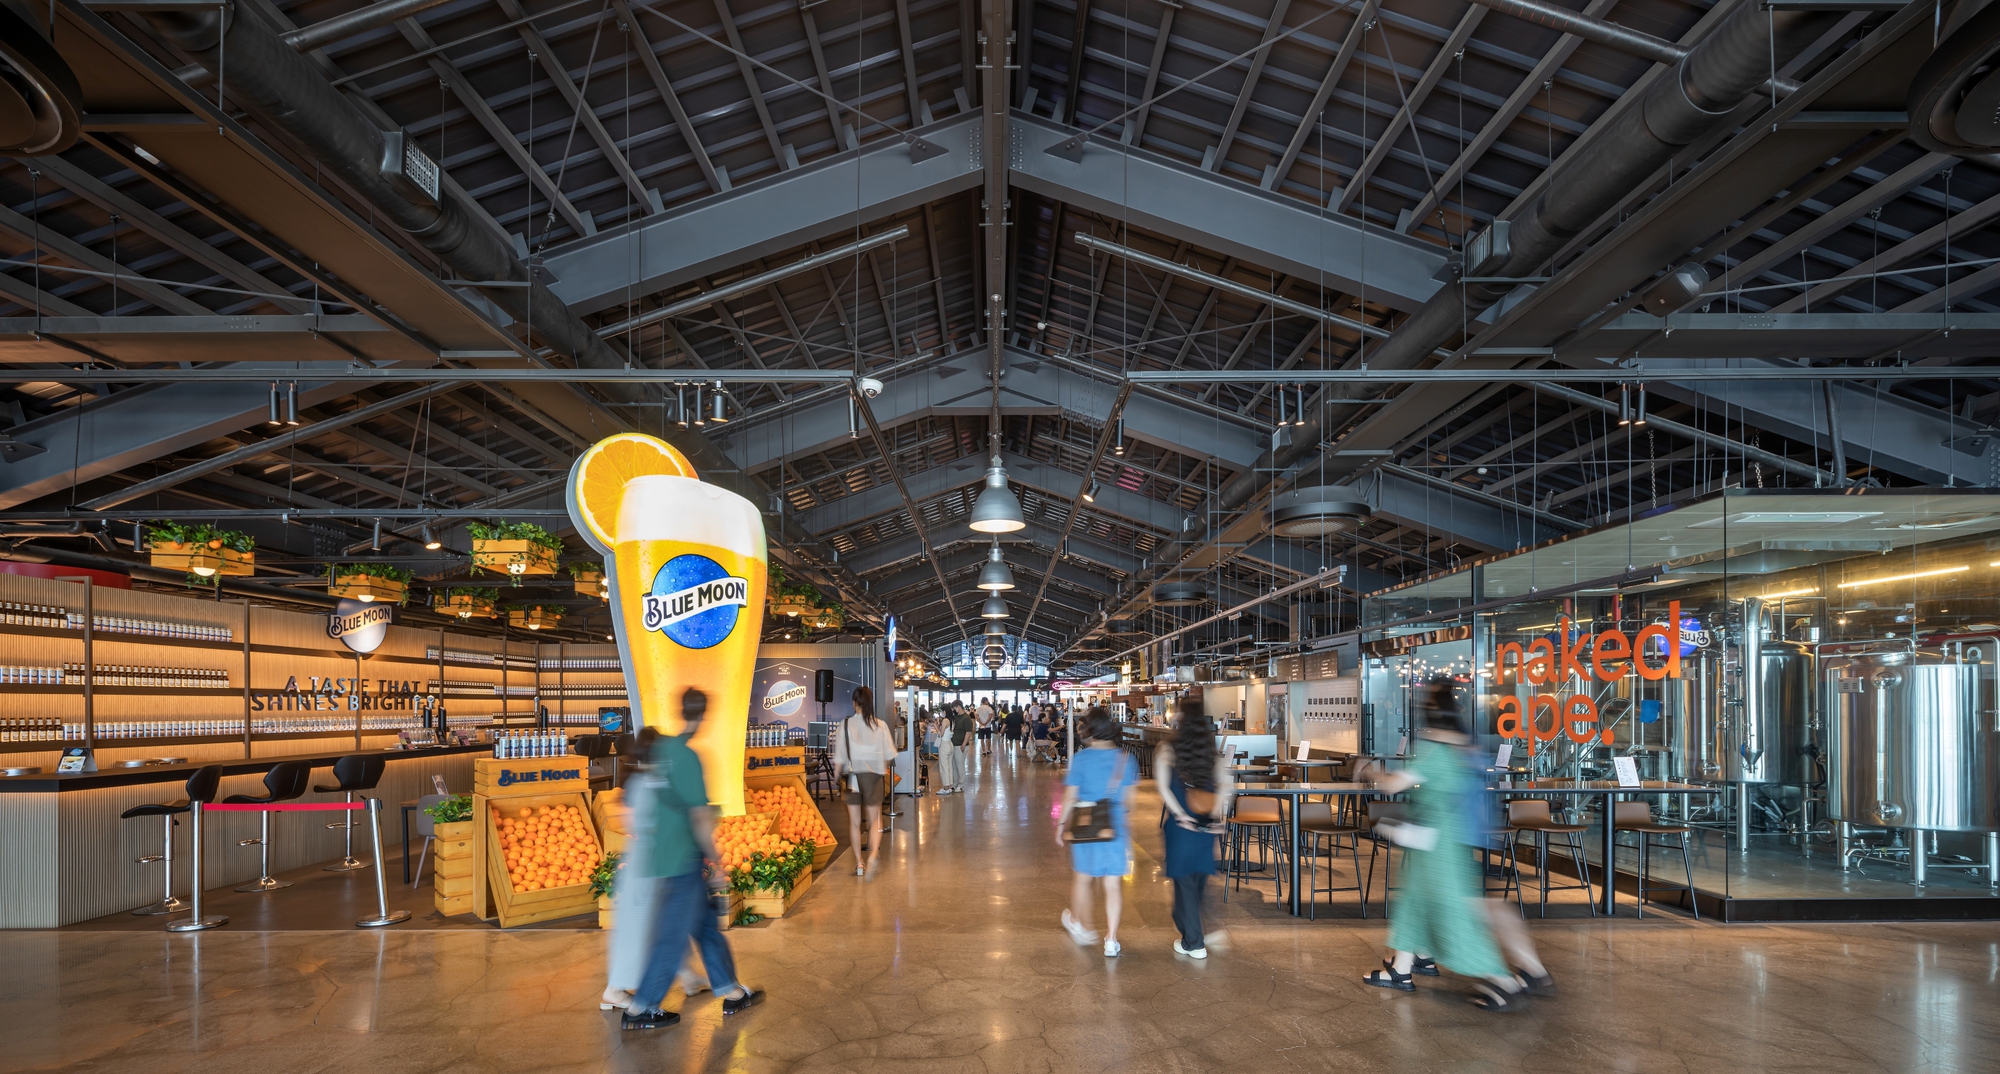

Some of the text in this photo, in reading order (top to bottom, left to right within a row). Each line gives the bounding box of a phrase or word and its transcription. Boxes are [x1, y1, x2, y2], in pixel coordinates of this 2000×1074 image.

[644, 582, 745, 628] BLUE MOON
[330, 607, 390, 635] BLUE MOON
[1497, 601, 1681, 685] naked
[284, 675, 421, 695] A TASTE THAT
[251, 693, 340, 712] SHINES
[764, 688, 806, 709] BLUE MOON
[1497, 694, 1615, 757] ape.
[748, 756, 800, 770] BLUE MOON
[498, 769, 580, 787] BLUE MOON
